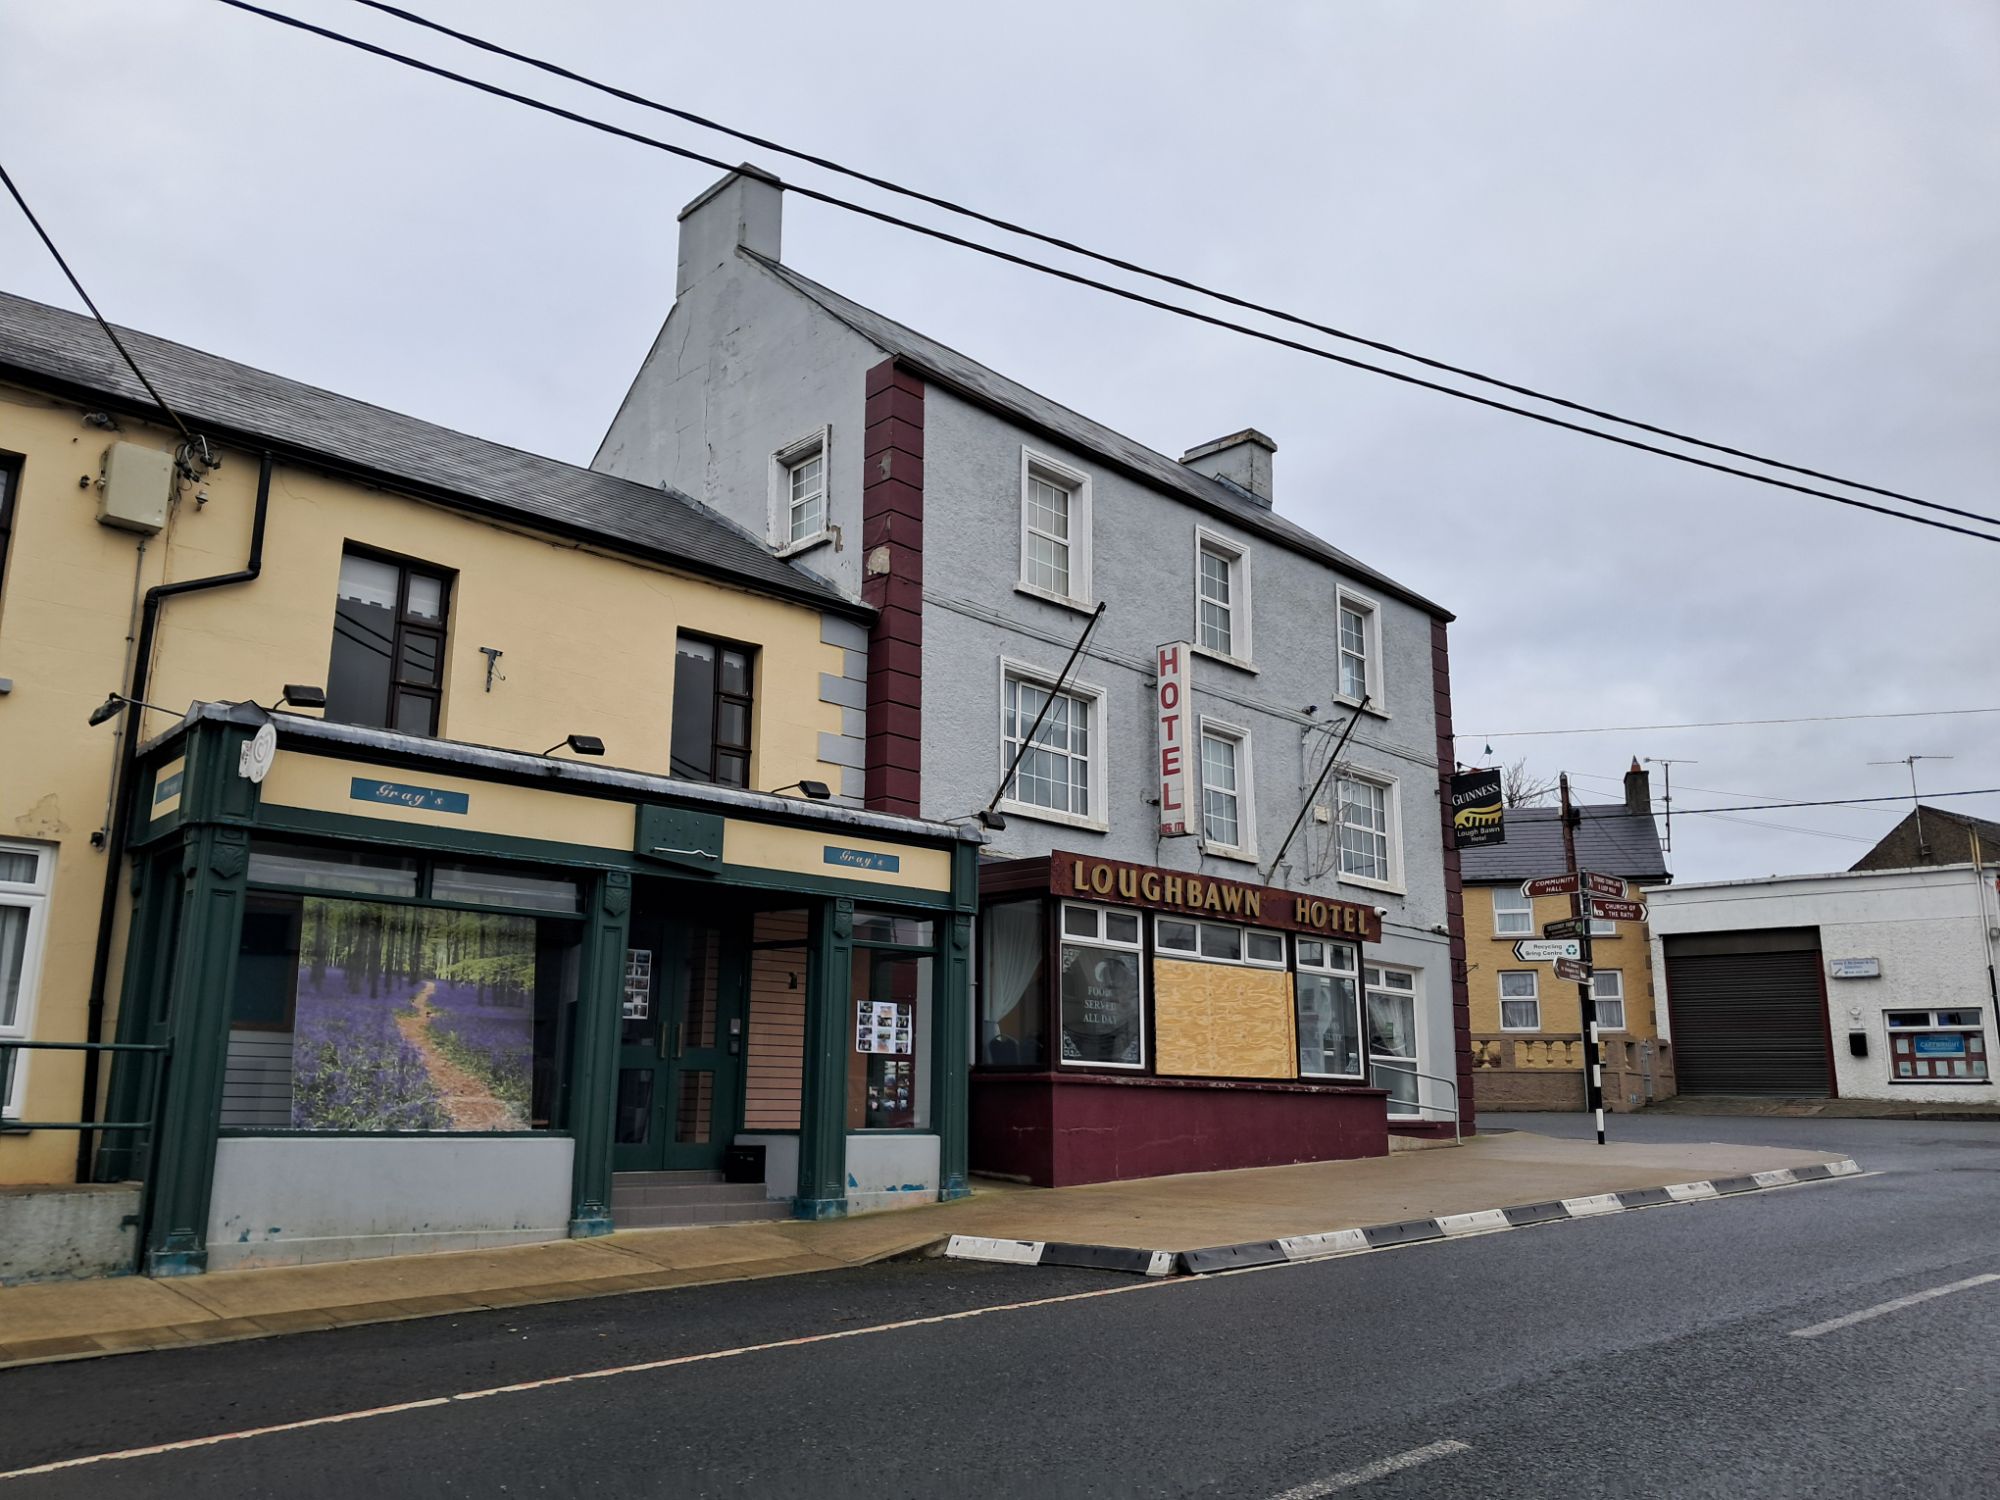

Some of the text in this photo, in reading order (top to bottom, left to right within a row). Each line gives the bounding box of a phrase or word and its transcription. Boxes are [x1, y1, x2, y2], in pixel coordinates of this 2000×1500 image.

[1160, 647, 1182, 811] HOTEL
[376, 784, 444, 806] Gray's
[1452, 783, 1500, 806] GUINNESS
[1457, 826, 1500, 837] Lough Bawn
[1535, 876, 1575, 887] COMMUNITY
[1545, 885, 1562, 893] HALL
[1073, 860, 1370, 936] LOUGHBAWN HOTEL
[1083, 1000, 1117, 1011] SERVED
[1083, 1013, 1118, 1025] ALL DAY
